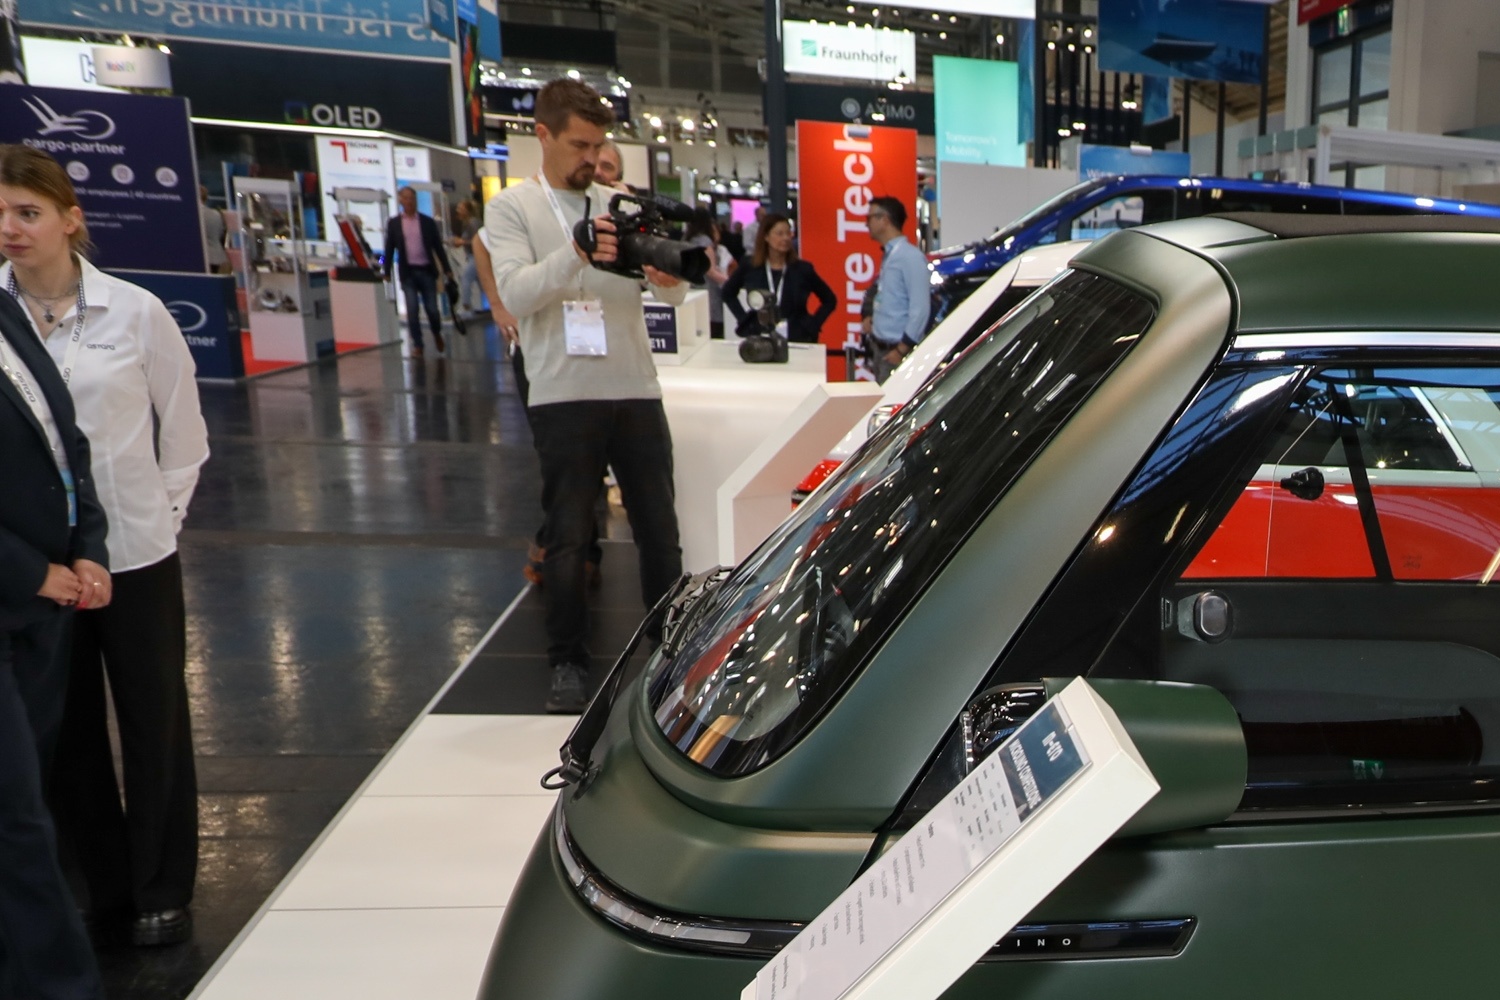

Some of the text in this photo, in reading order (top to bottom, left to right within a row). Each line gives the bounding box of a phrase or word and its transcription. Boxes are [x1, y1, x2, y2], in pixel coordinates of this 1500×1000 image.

[821, 45, 898, 66] Fraunhofer
[311, 103, 382, 129] OLED
[22, 137, 126, 156] cargo-partner
[833, 123, 875, 243] Tech
